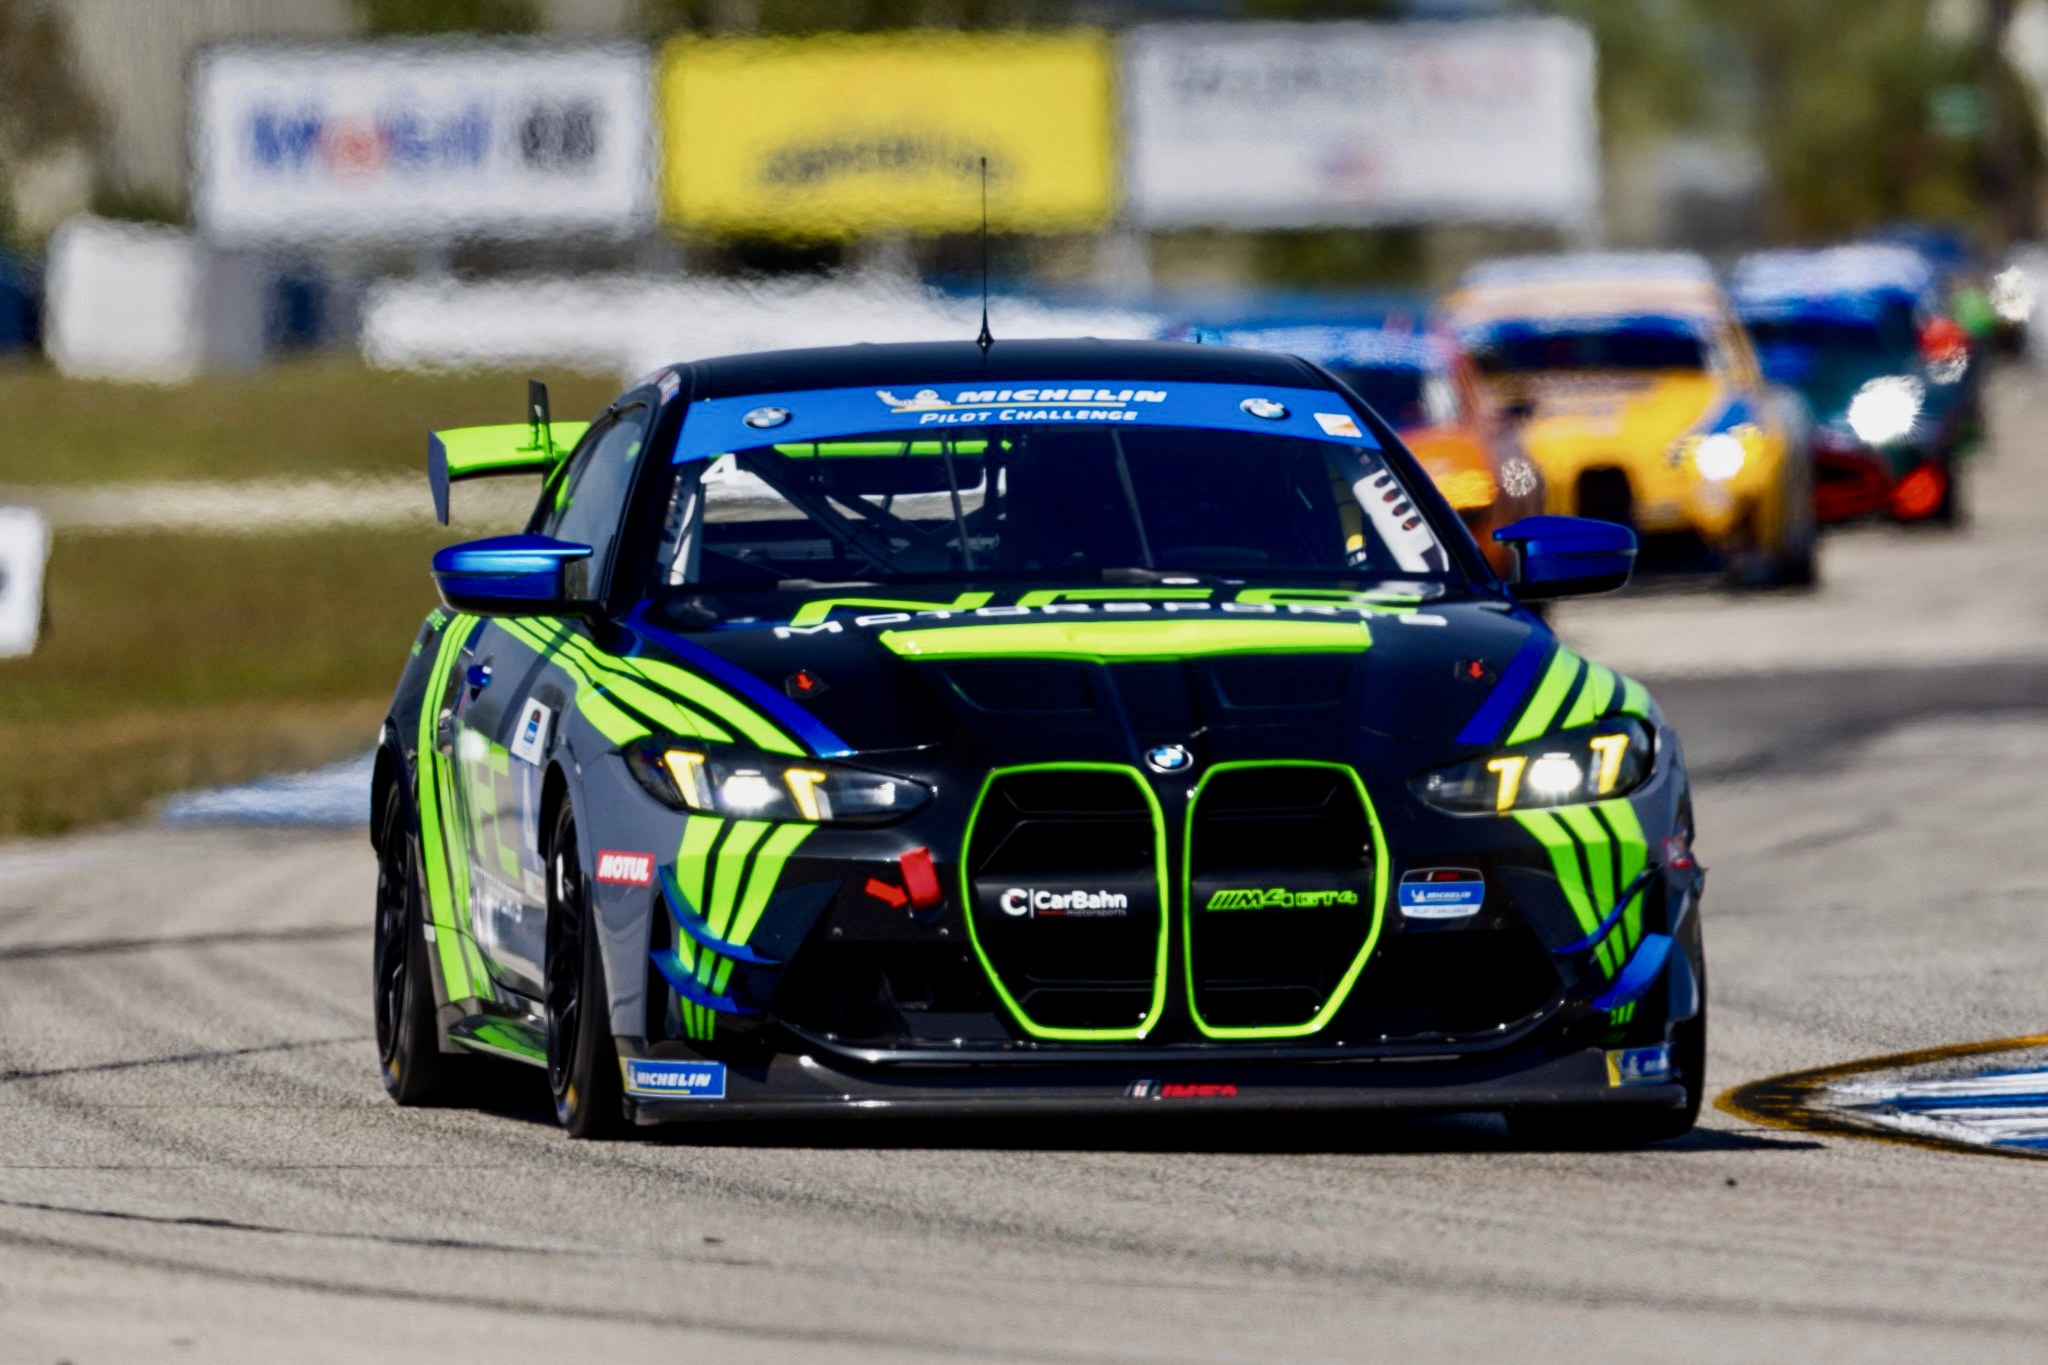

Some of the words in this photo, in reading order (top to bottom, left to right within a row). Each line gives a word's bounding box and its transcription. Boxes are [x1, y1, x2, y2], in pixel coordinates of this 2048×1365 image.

[956, 389, 1168, 403] MICHELIN
[919, 412, 992, 424] PILOT
[999, 409, 1139, 422] CHALLENGE
[598, 855, 649, 882] MOTUL
[1034, 890, 1128, 909] CarBahn
[637, 1072, 712, 1087] MICHELIN
